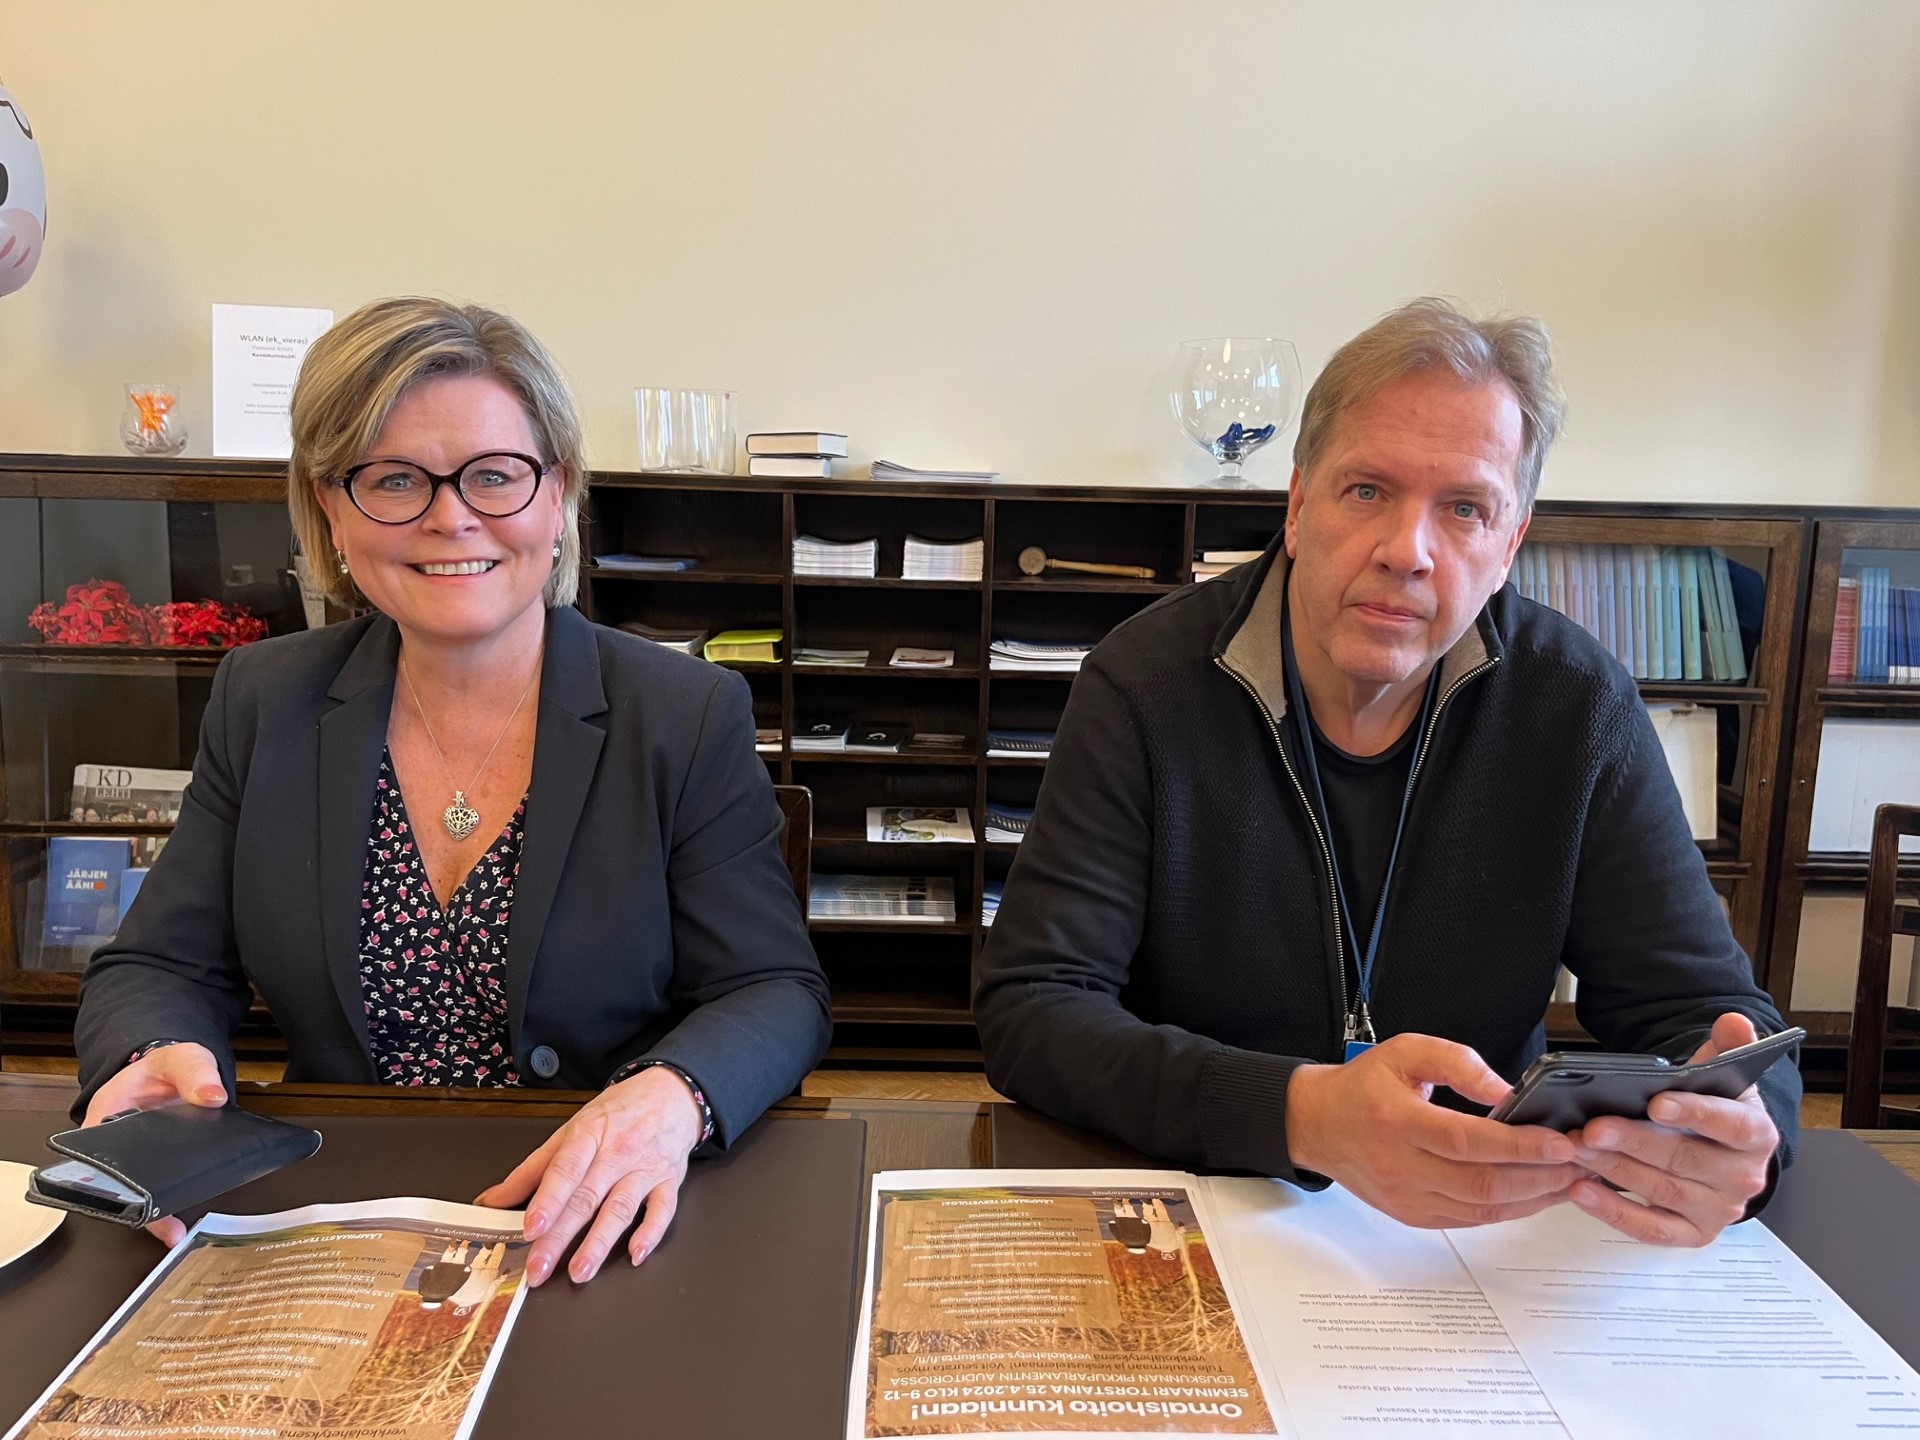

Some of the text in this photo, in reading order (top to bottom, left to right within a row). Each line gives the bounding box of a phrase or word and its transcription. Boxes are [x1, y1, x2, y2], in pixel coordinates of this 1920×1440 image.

[239, 334, 264, 342] WLAN
[97, 769, 133, 787] KD
[95, 787, 131, 798] LEHTI
[66, 868, 108, 879] JÄRJEN
[65, 879, 94, 889] ÄÄNI
[321, 1232, 383, 1242] LÄMPIMÄSTI
[353, 1274, 376, 1282] 11.20
[351, 1302, 376, 1310] 10.30
[912, 1350, 1205, 1364] verkkolähetyksenä verkkolahetys.eduskunta.fi/fi/
[218, 1368, 280, 1376] Omaishoidon
[897, 1361, 1224, 1374] Tule kuulemaan ja keskustelemaan! Voit seurata myös
[280, 1370, 302, 1378] 9.10
[890, 1371, 1235, 1386] EDUSKUNNAN PIKKUPARLAMENTIN AUDITORIOSSA
[924, 1387, 959, 1398] KLO
[963, 1384, 1047, 1396] 25.4.2024
[1050, 1384, 1150, 1396] TORSTAINA
[1152, 1386, 1249, 1398] SEMINAARI
[910, 1399, 1243, 1420] Omaishoito kunniaan!
[1375, 1406, 1416, 1414] kasvanut
[1341, 1415, 1381, 1423] lainkaan
[72, 1424, 407, 1439] verkkolähetyksenä verkkolahetys.eduskunta.fi/fi/
